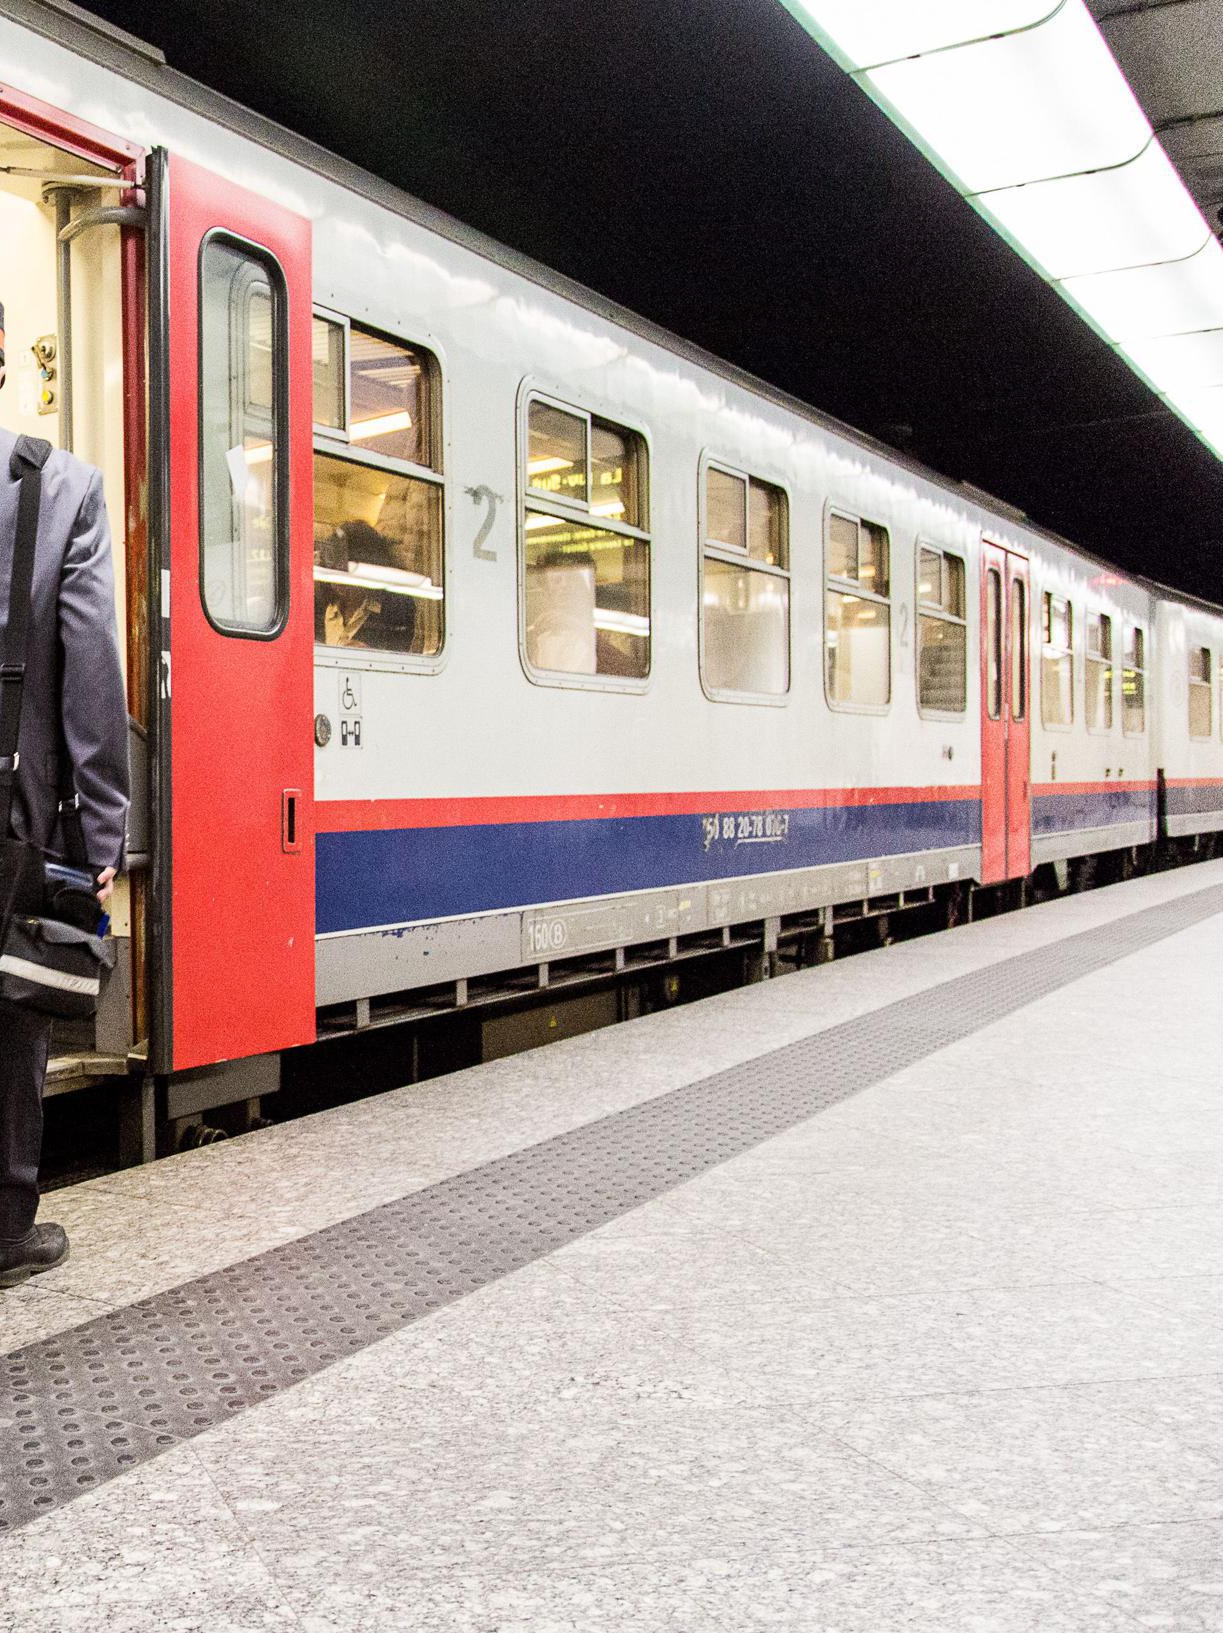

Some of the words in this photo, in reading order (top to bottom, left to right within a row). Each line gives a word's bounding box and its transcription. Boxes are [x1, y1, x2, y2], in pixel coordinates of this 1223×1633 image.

[471, 485, 498, 562] 2
[722, 817, 735, 839] 88
[737, 815, 764, 838] 20-78
